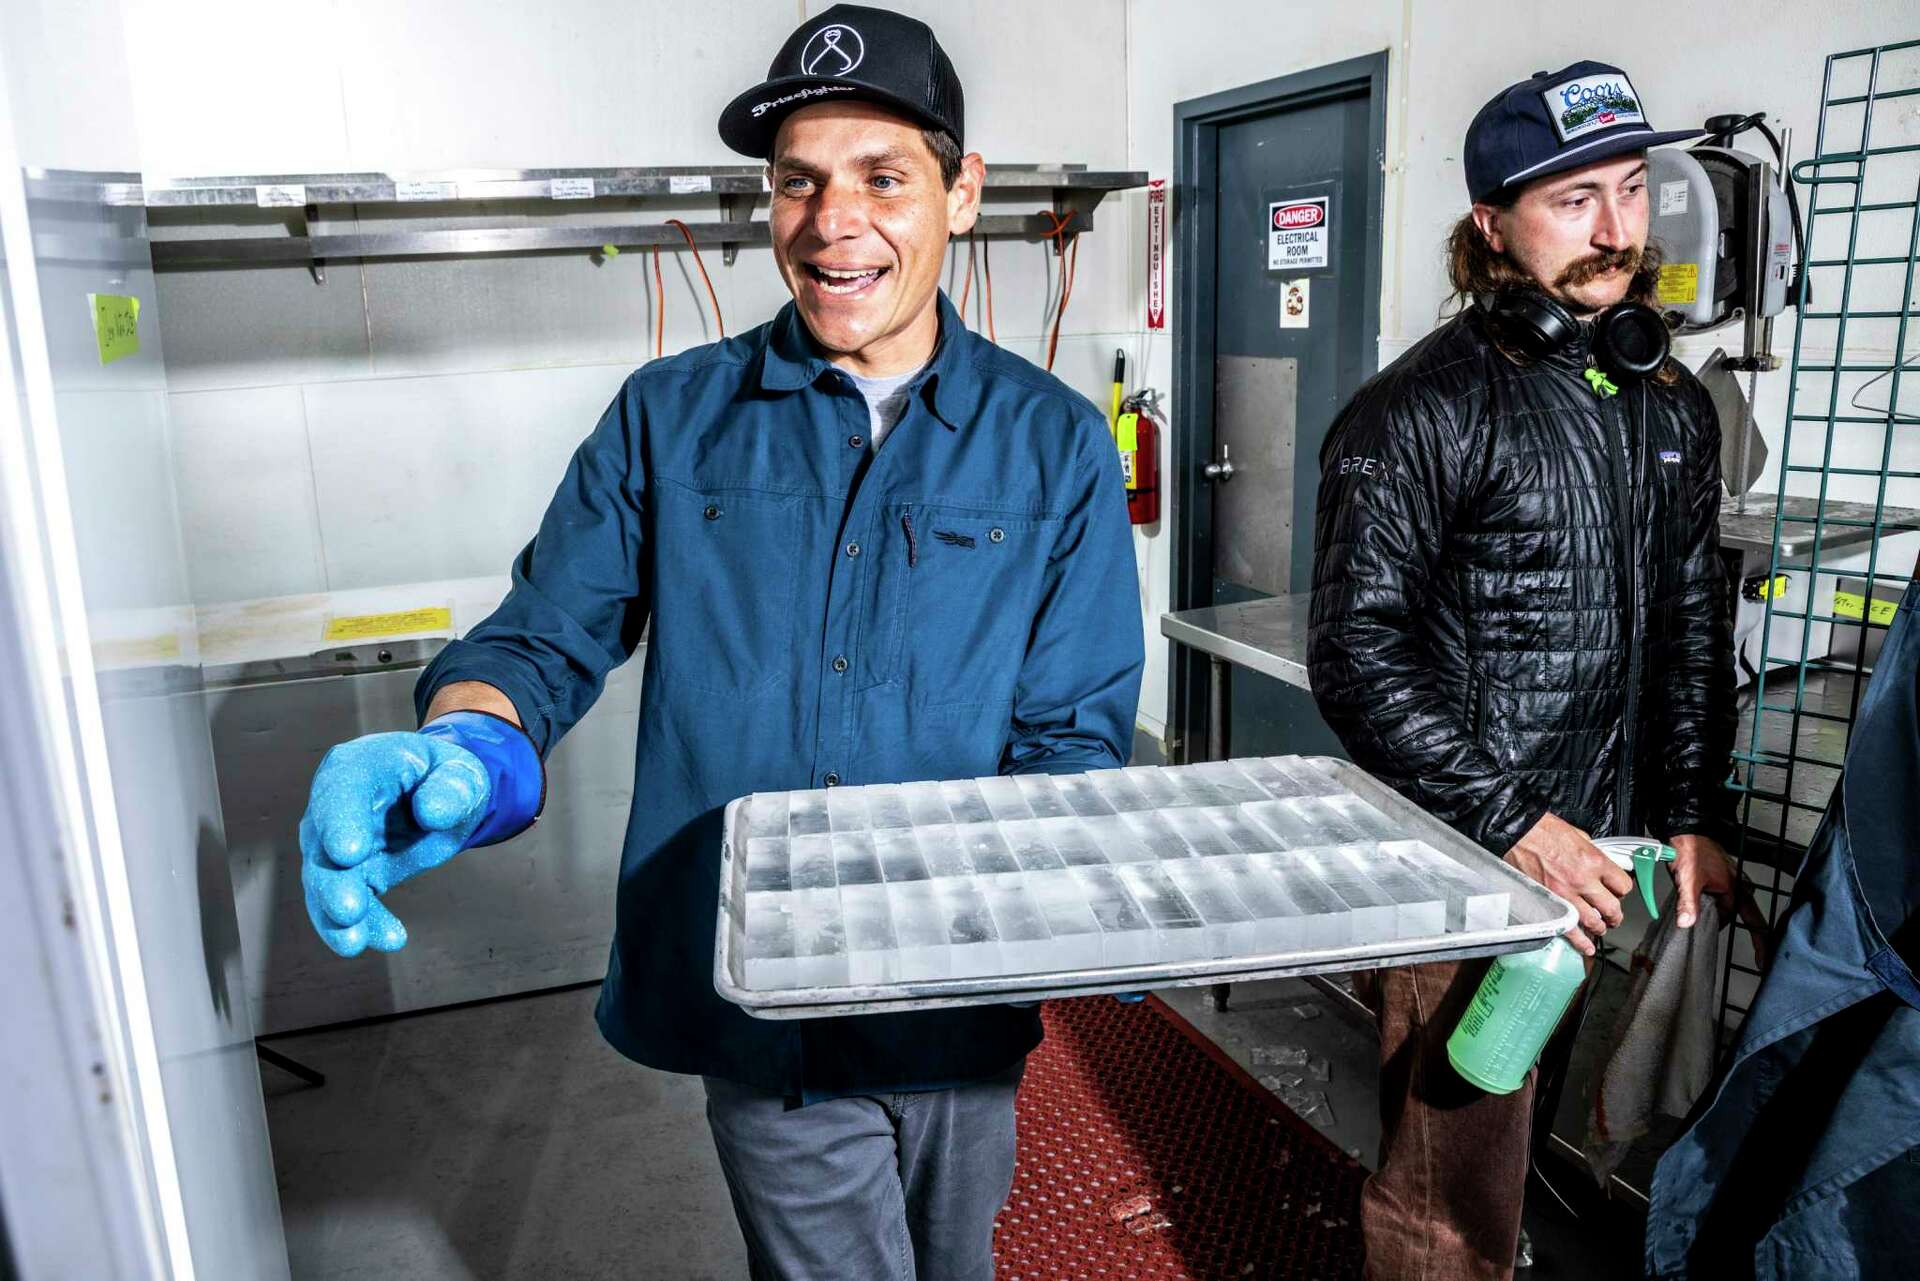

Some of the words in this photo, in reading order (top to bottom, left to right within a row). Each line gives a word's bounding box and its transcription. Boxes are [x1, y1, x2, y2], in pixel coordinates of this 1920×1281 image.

[751, 85, 857, 118] Prizefighter
[1560, 83, 1624, 107] Coors
[1149, 189, 1164, 203] FIRE
[1279, 208, 1318, 225] DANGER
[1277, 231, 1319, 245] ELECTRICAL
[1287, 245, 1308, 256] ROOM
[1152, 206, 1160, 317] EXTINGUISHER
[1280, 257, 1298, 265] STORAGE
